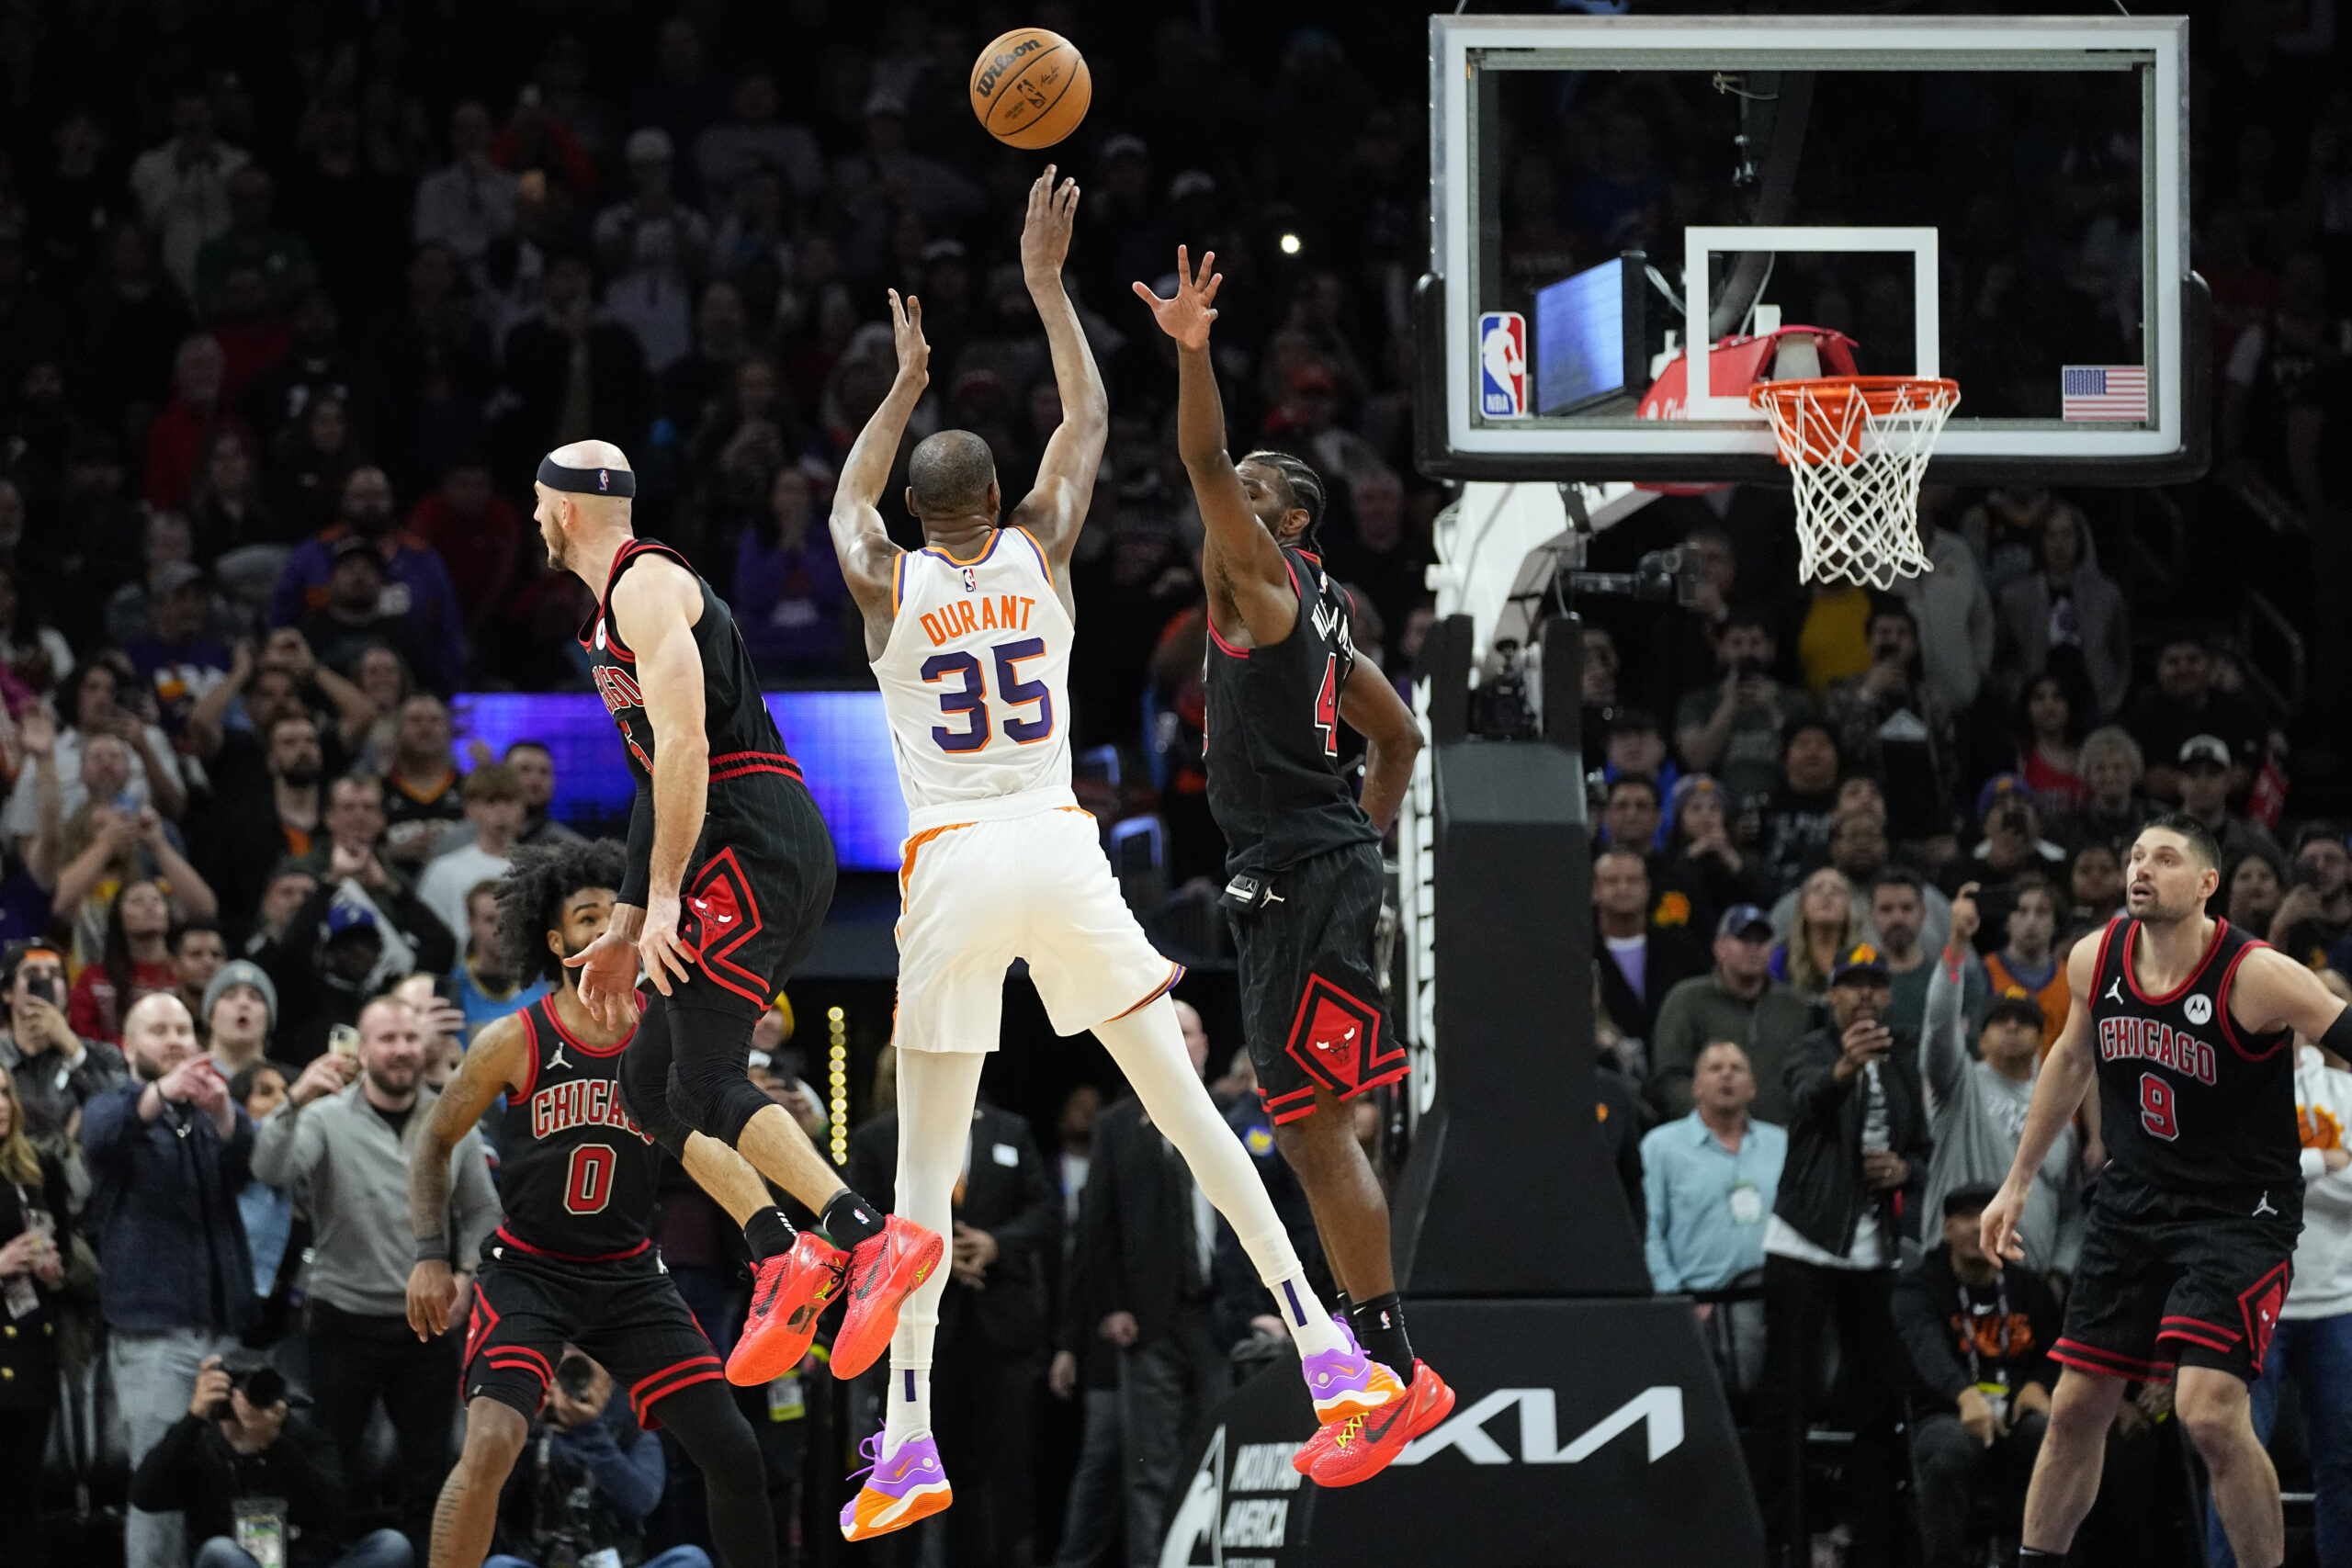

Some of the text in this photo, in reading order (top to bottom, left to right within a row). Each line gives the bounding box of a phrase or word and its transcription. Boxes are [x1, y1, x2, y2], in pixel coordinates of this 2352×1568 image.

[977, 39, 1043, 97] Wilson
[1487, 393, 1510, 412] NBA
[920, 595, 1035, 647] DURANT
[921, 637, 1054, 753] 35
[1315, 652, 1351, 757] 4
[2099, 1016, 2217, 1086] CHICAGO
[532, 1079, 654, 1145] CHICA
[2140, 1072, 2179, 1142] 9
[563, 1144, 616, 1214] 0
